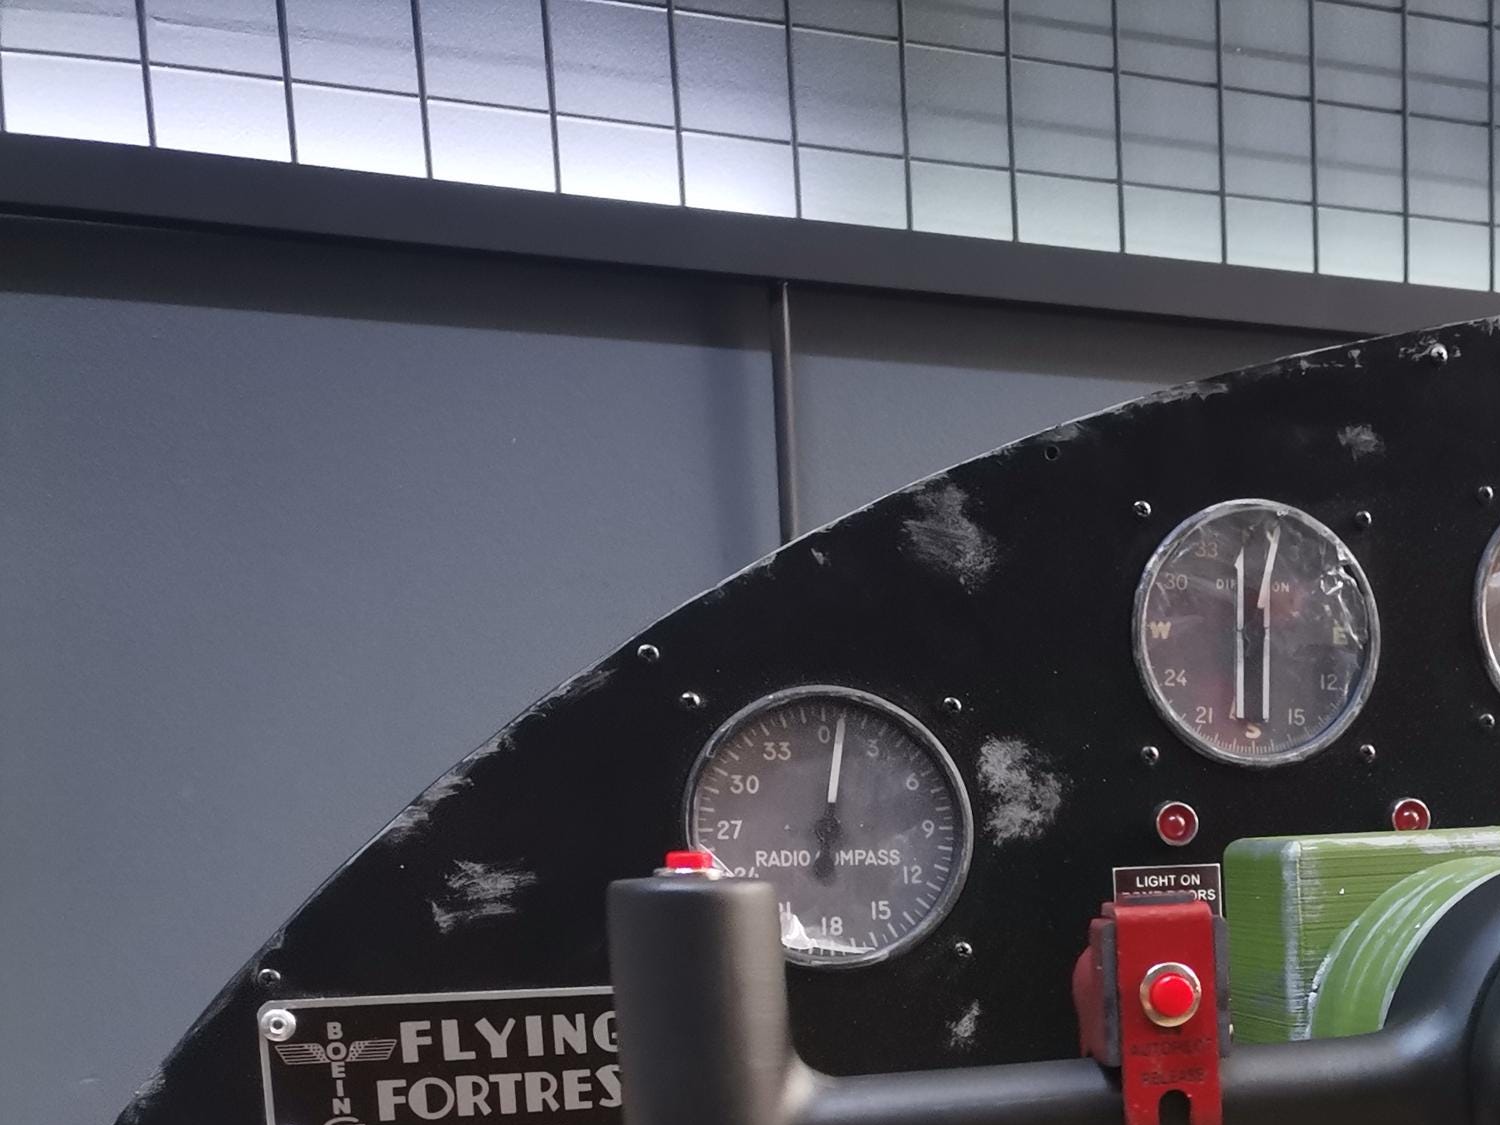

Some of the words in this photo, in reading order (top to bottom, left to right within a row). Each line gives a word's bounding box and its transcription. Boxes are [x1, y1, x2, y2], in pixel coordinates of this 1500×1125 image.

[1164, 574, 1188, 590] 30
[1150, 622, 1171, 640] W
[1332, 626, 1348, 644] E
[1164, 670, 1187, 686] 24
[1196, 708, 1212, 723] 21
[1288, 709, 1305, 724] 15
[763, 742, 791, 761] 33
[730, 775, 759, 794] 30
[906, 774, 919, 790] 6
[717, 820, 742, 839] 27
[922, 820, 934, 837] 9
[756, 851, 810, 867] RADIO
[904, 867, 922, 884] 12
[1136, 875, 1176, 887] LIGHT
[1181, 874, 1200, 885] ON
[872, 902, 891, 919] 15
[821, 917, 843, 935] 18
[376, 1064, 622, 1122] FORTRES
